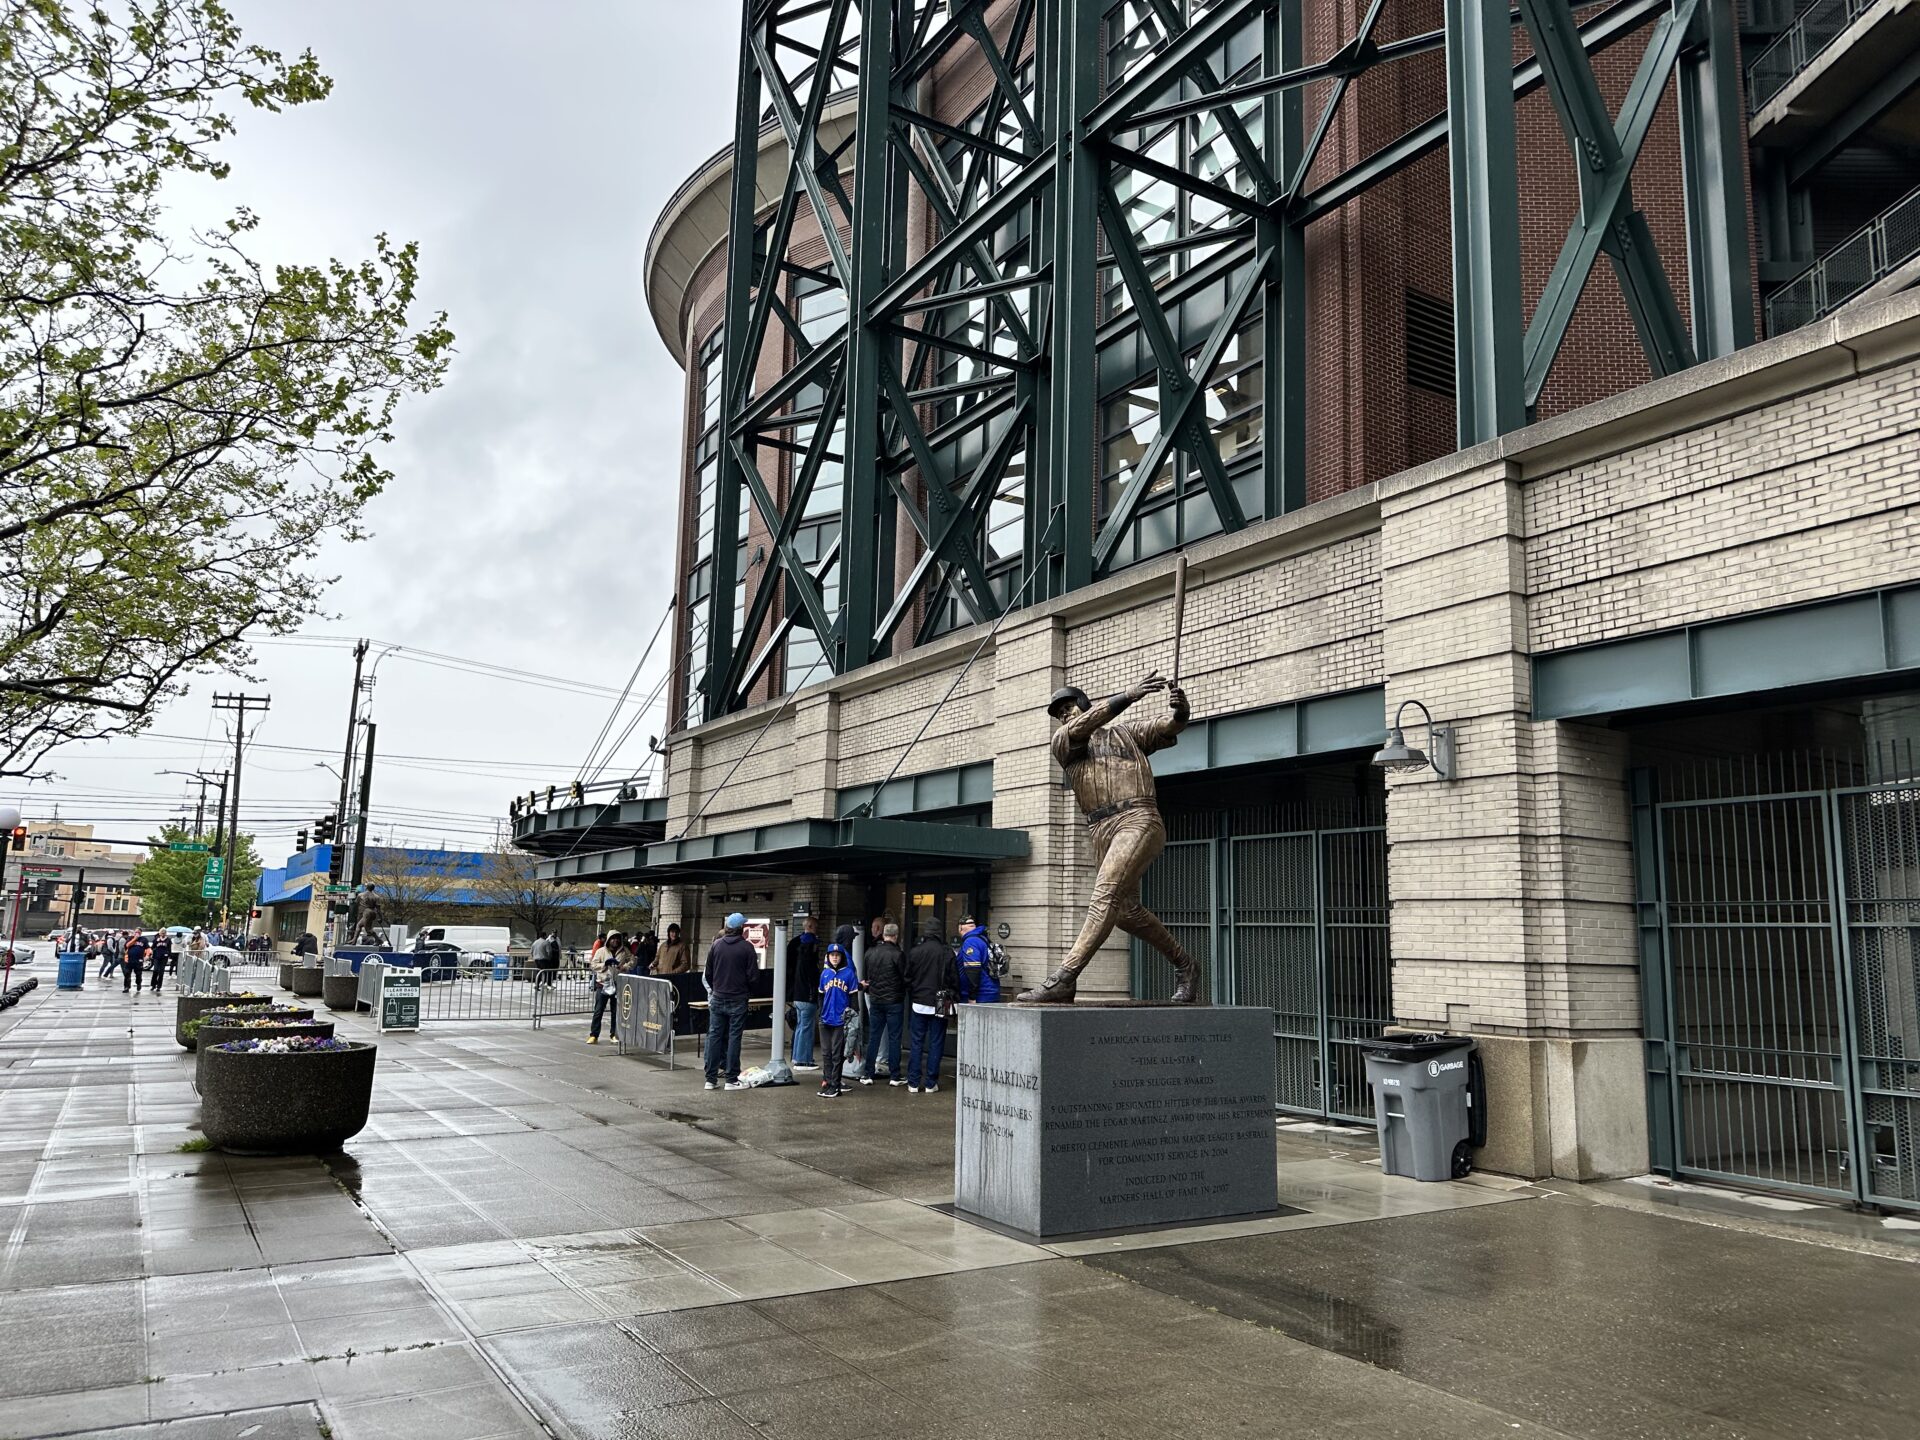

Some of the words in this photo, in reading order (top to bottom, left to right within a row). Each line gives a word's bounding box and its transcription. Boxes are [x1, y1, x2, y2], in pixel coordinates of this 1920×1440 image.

[1097, 1035, 1139, 1045] AMERICAN
[1142, 1034, 1171, 1044] LEAGUE
[1174, 1034, 1206, 1043] BATTING
[1208, 1033, 1232, 1042] TITLES
[1439, 1060, 1464, 1071] GARBAGE
[959, 1062, 988, 1081] EDGAR
[990, 1068, 1039, 1091] MARTINEZ
[1119, 1078, 1145, 1088] SILVER
[1147, 1077, 1181, 1087] SLUGGER
[1183, 1076, 1214, 1086] AWARDS
[962, 1096, 993, 1112] SEATTLE
[994, 1101, 1033, 1122] MARINERS
[1057, 1102, 1113, 1114] OUTSTANDING
[1115, 1099, 1162, 1110] DESIGNATED
[1164, 1097, 1190, 1108] HITTER
[1204, 1096, 1218, 1106] THE
[1239, 1094, 1267, 1104] AWARDS
[1045, 1119, 1083, 1131] RENAMED
[1086, 1118, 1100, 1129] THE
[1103, 1117, 1128, 1128] EDGAR
[1130, 1115, 1168, 1126] MARTINEZ
[1170, 1113, 1195, 1123] AWARD
[1197, 1112, 1216, 1121] UPON
[1218, 1111, 1230, 1120] HIS
[1232, 1109, 1274, 1119] RETIREMENT
[1050, 1142, 1086, 1153] ROBERTO
[1088, 1139, 1129, 1151] CLEMENTE
[1131, 1137, 1158, 1148] AWARD
[1160, 1136, 1180, 1145] FROM
[1182, 1134, 1206, 1144] MAJOR
[1207, 1132, 1234, 1142] LEAGUE
[1236, 1130, 1269, 1140] BASEBALL
[1098, 1157, 1114, 1166] FOR
[1116, 1152, 1165, 1165] COMMUNITY
[1167, 1150, 1198, 1161] SERVICE
[1200, 1149, 1210, 1158] IN
[1211, 1147, 1229, 1157] 2004
[1125, 1174, 1166, 1187] INDUCTED
[1168, 1172, 1188, 1183] INTO
[1190, 1170, 1206, 1181] THE
[1099, 1192, 1140, 1204] MARINERS
[1142, 1189, 1163, 1201] HALL
[1165, 1188, 1176, 1199] OF
[1178, 1186, 1199, 1197] FAME
[1201, 1185, 1211, 1195] IN
